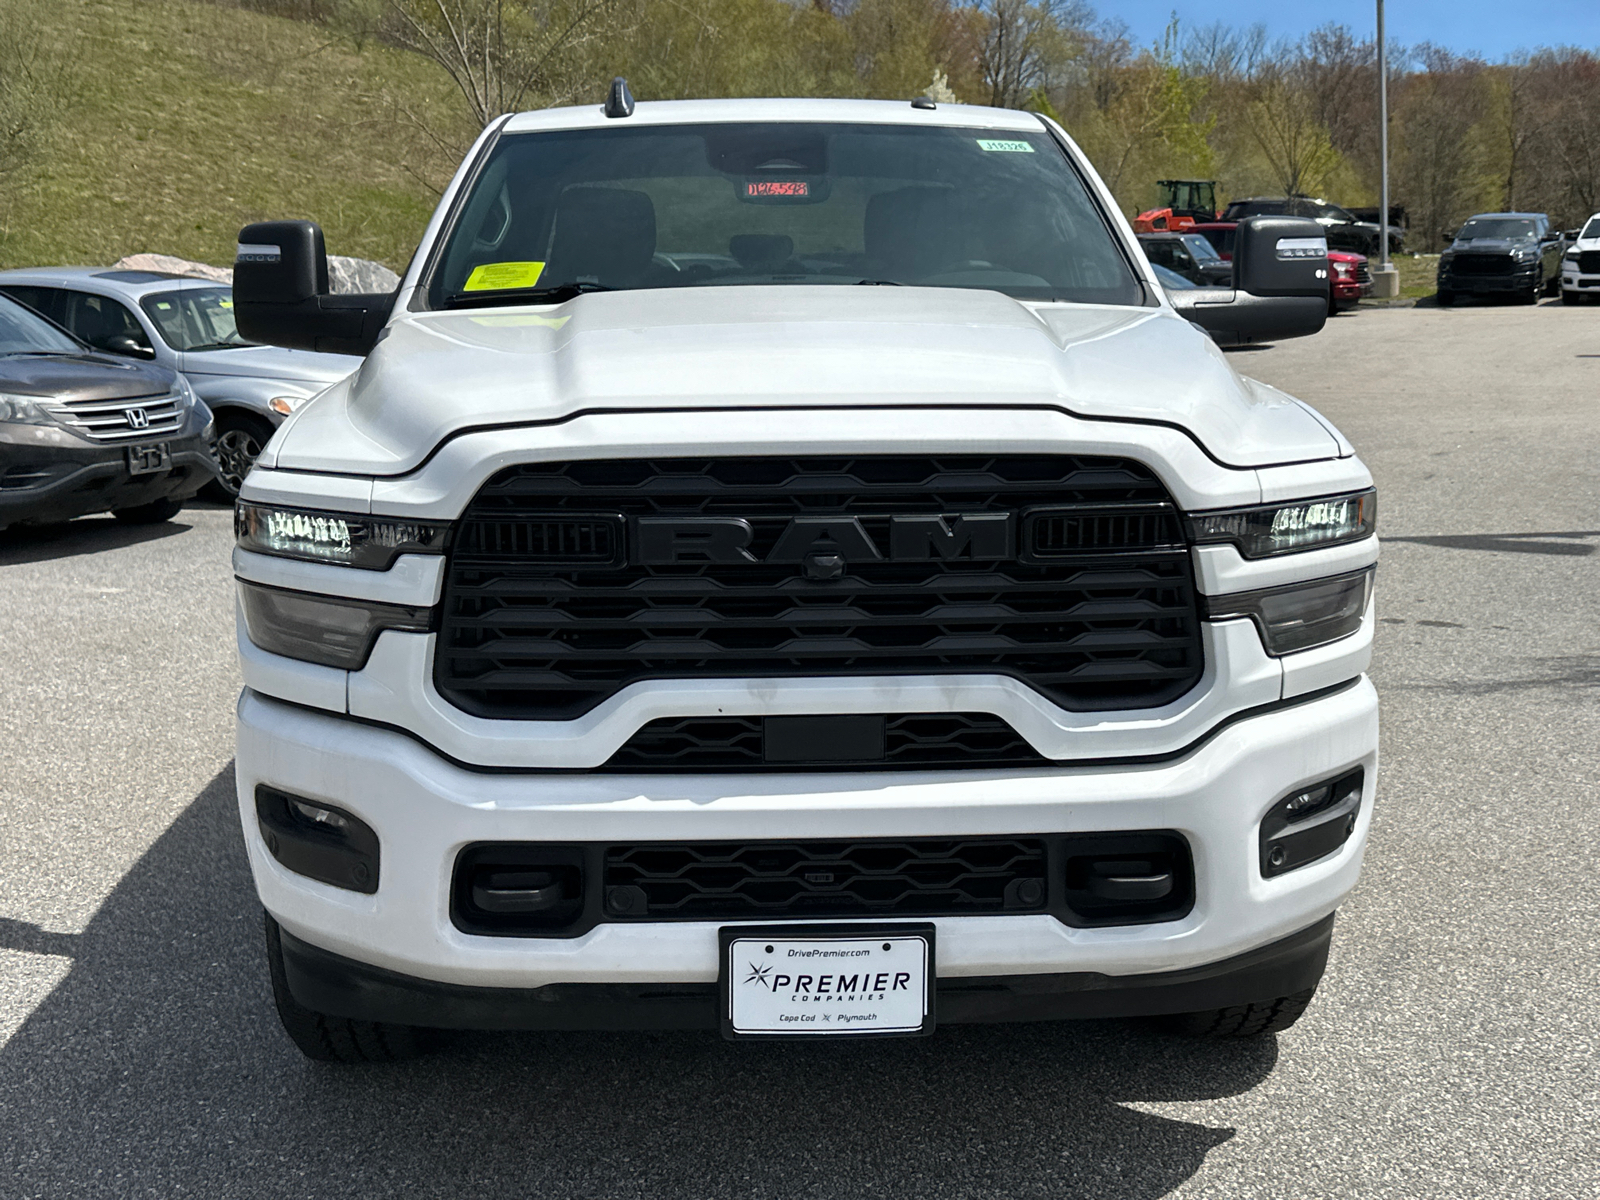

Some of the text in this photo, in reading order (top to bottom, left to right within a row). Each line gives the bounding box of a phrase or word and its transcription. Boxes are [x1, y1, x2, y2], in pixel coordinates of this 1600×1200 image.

[986, 142, 1027, 151] J18326
[637, 513, 1012, 563] RAM
[787, 949, 870, 958] DrivePremier.com
[771, 972, 911, 993] PREMIER
[791, 993, 885, 1002] COMPANIES
[779, 1013, 878, 1023] Cape Cod Plymouth
